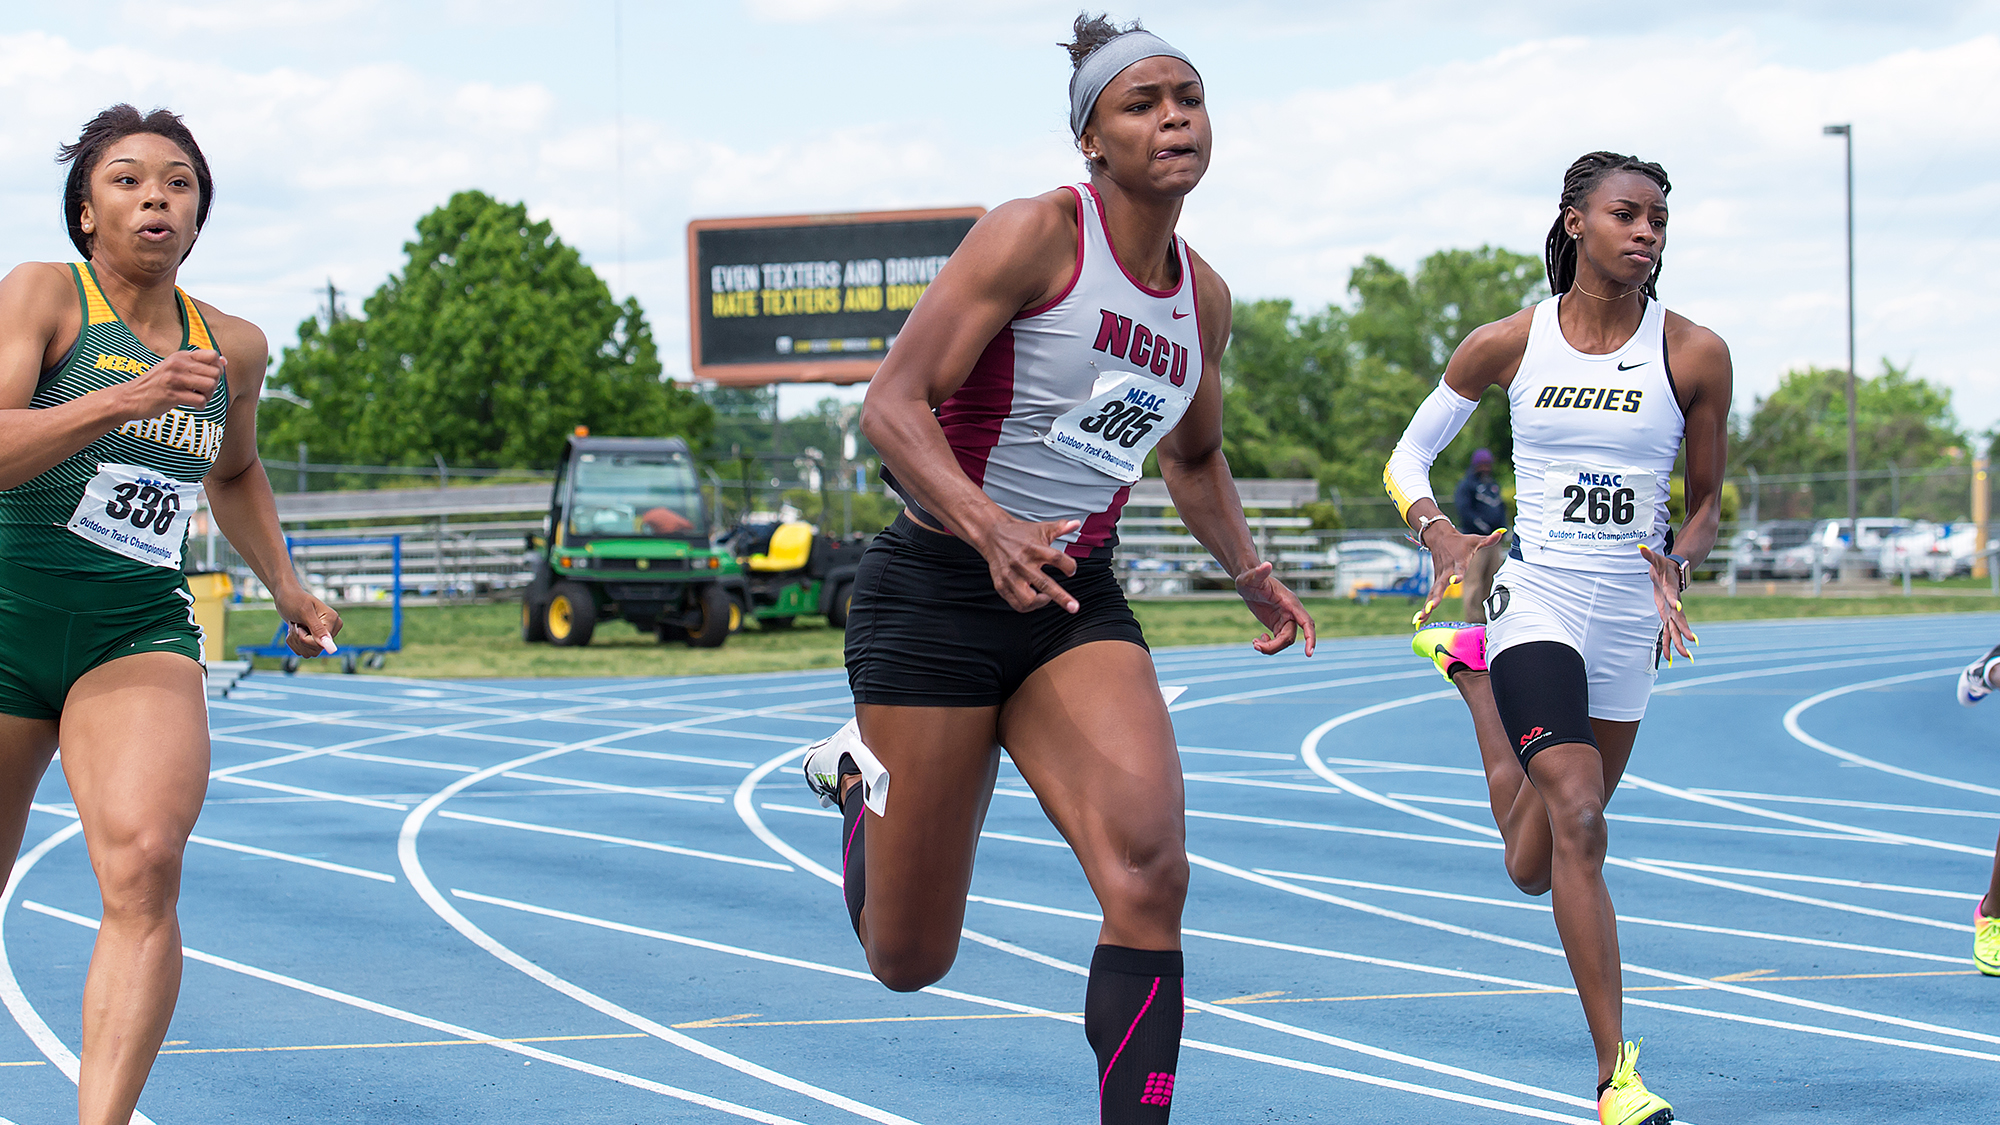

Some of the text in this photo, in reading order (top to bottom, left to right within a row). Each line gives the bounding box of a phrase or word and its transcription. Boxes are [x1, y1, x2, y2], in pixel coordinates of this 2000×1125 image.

[711, 264, 760, 293] EVEN
[761, 260, 842, 290] TEXTERS
[843, 258, 883, 287] AND
[712, 284, 928, 318] HATE TEXTERS AND DRIV
[94, 354, 150, 376] MEAC
[1092, 309, 1188, 388] NCCU
[1125, 387, 1166, 412] MEAC
[1534, 386, 1643, 414] AGGIES
[1079, 400, 1164, 448] 305
[1057, 431, 1084, 450] Outdoor
[1083, 442, 1103, 458] Track
[1578, 472, 1622, 487] MEAC
[105, 482, 180, 536] 336
[1562, 484, 1635, 525] 266
[80, 517, 110, 536] Outdoor
[111, 529, 130, 544] Track
[130, 536, 173, 560] Championships
[1549, 529, 1648, 541] Outdoor Track Championships
